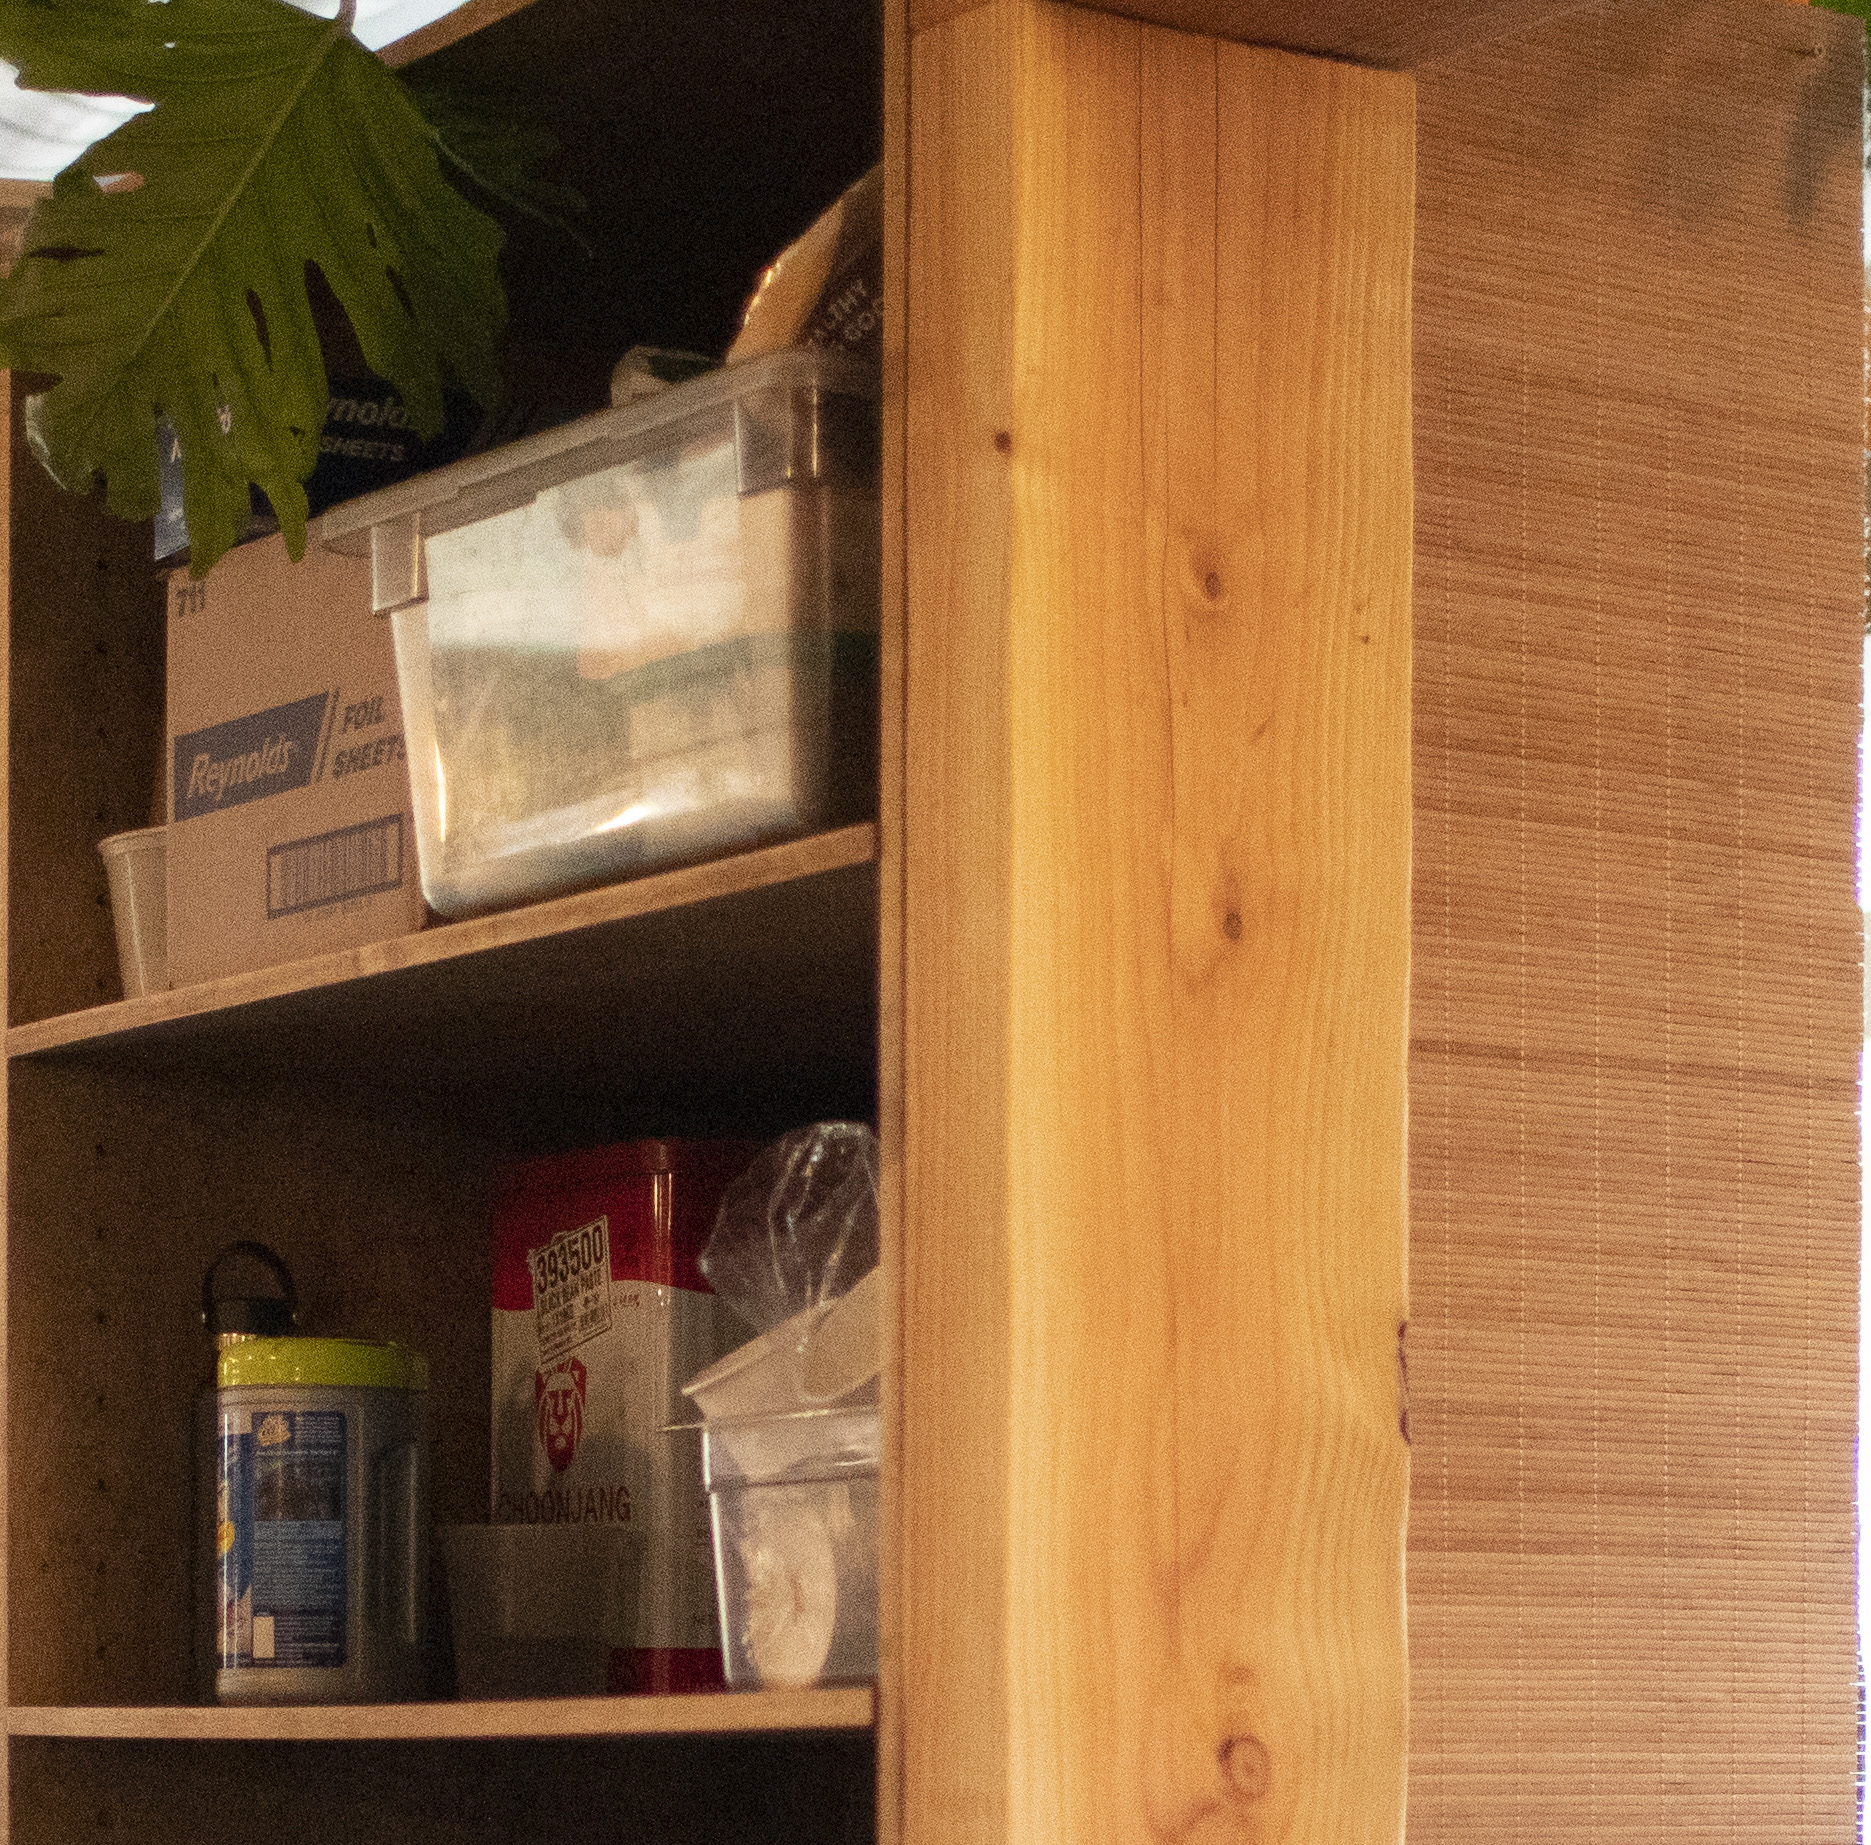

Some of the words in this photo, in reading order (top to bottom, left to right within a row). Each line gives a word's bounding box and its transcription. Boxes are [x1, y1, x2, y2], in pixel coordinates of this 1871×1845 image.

[341, 696, 385, 734] FOIL
[187, 732, 296, 802] Reynolds
[330, 734, 405, 781] SHEETS
[537, 1224, 604, 1294] 393500
[497, 1485, 630, 1524] CHOONJANG
